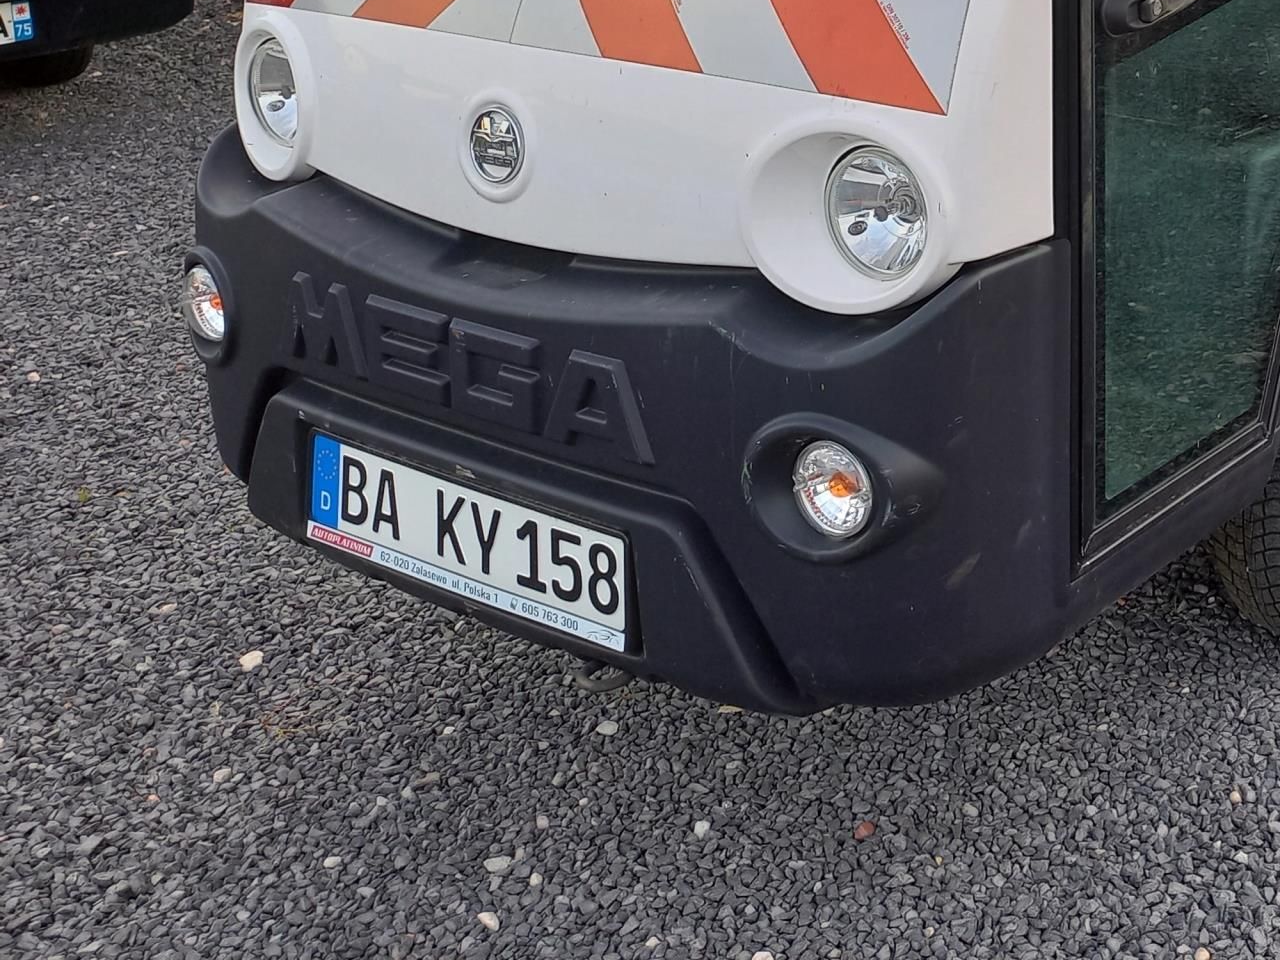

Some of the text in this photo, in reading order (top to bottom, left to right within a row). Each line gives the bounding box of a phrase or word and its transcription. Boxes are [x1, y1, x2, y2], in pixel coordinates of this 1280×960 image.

[15, 23, 32, 38] 75
[283, 271, 656, 466] MEGA
[320, 490, 330, 511] D
[313, 527, 371, 556] AUTOPLATINUM
[341, 455, 619, 616] BA KY 158
[380, 551, 409, 570] 62-020
[411, 562, 447, 584] Zalasewo
[464, 582, 491, 601] Polska
[493, 594, 499, 603] 1
[521, 604, 539, 617] 605
[542, 609, 558, 624] 763
[560, 616, 578, 631] 300
